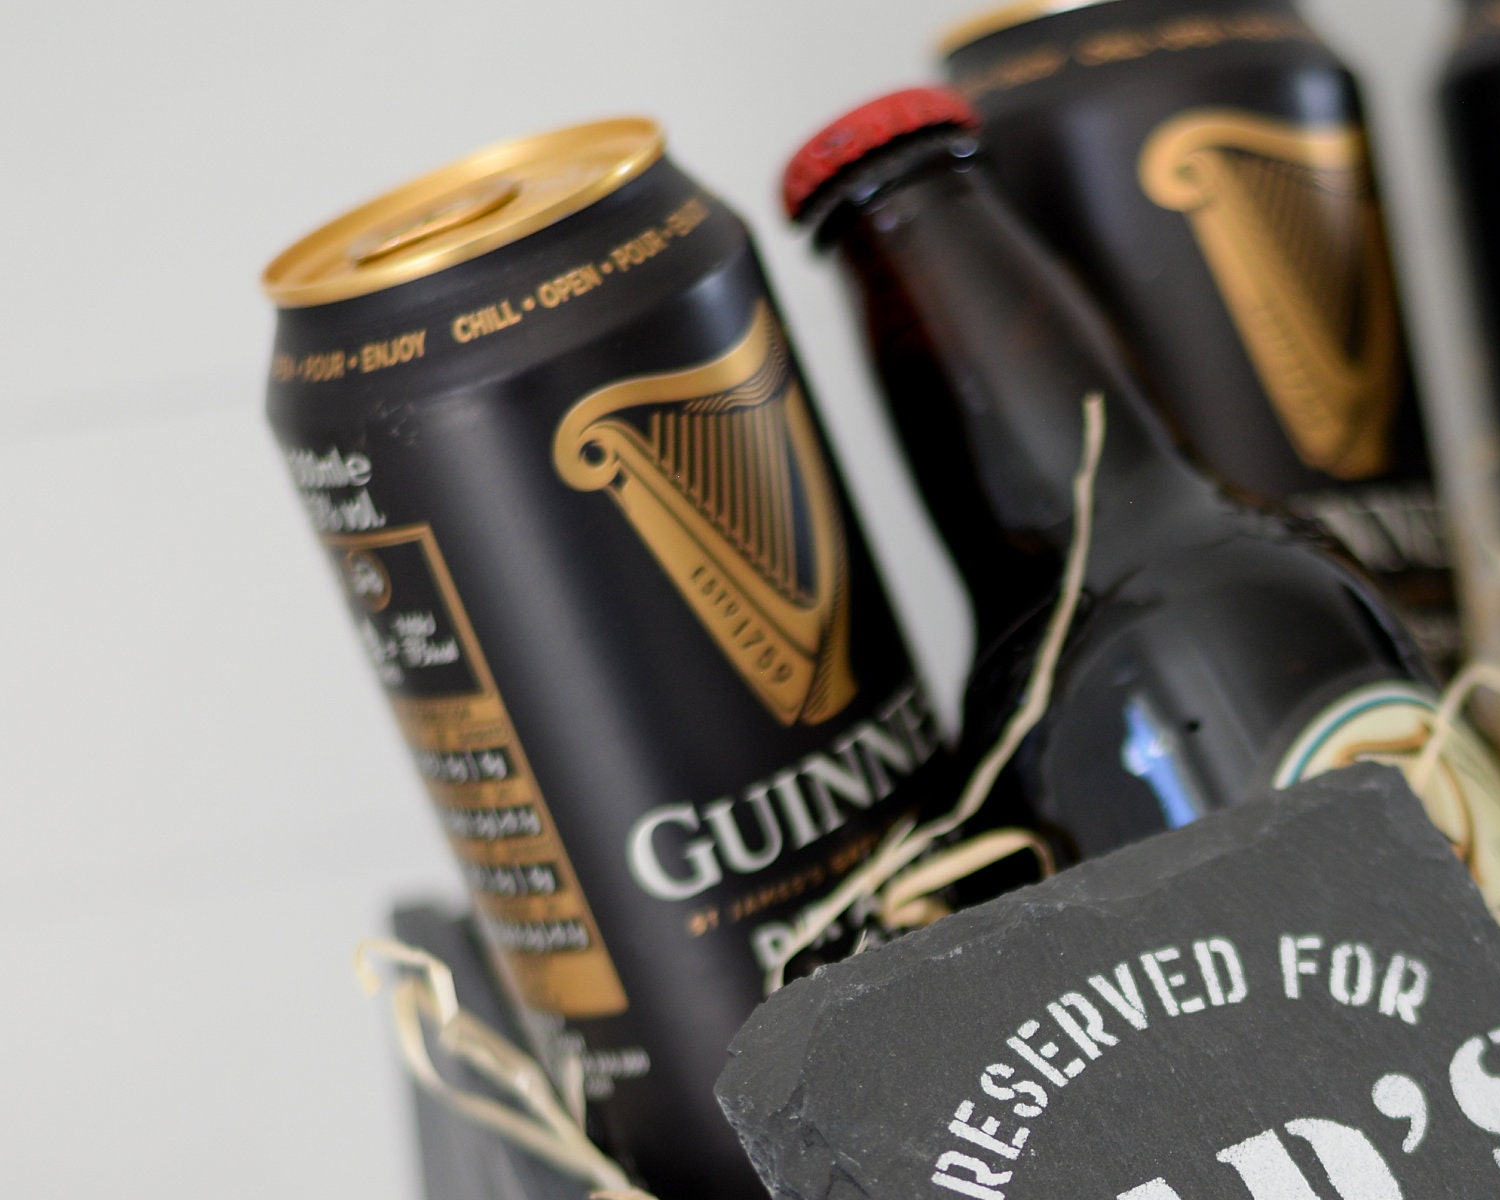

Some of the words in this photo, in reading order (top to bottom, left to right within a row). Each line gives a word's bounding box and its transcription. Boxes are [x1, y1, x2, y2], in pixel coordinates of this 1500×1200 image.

[450, 300, 523, 345] CHILL
[536, 262, 604, 310] OPEN
[611, 228, 671, 273] POUR
[360, 330, 427, 374] ENJOY
[732, 620, 794, 683] 1759
[1279, 935, 1430, 1024] FOR
